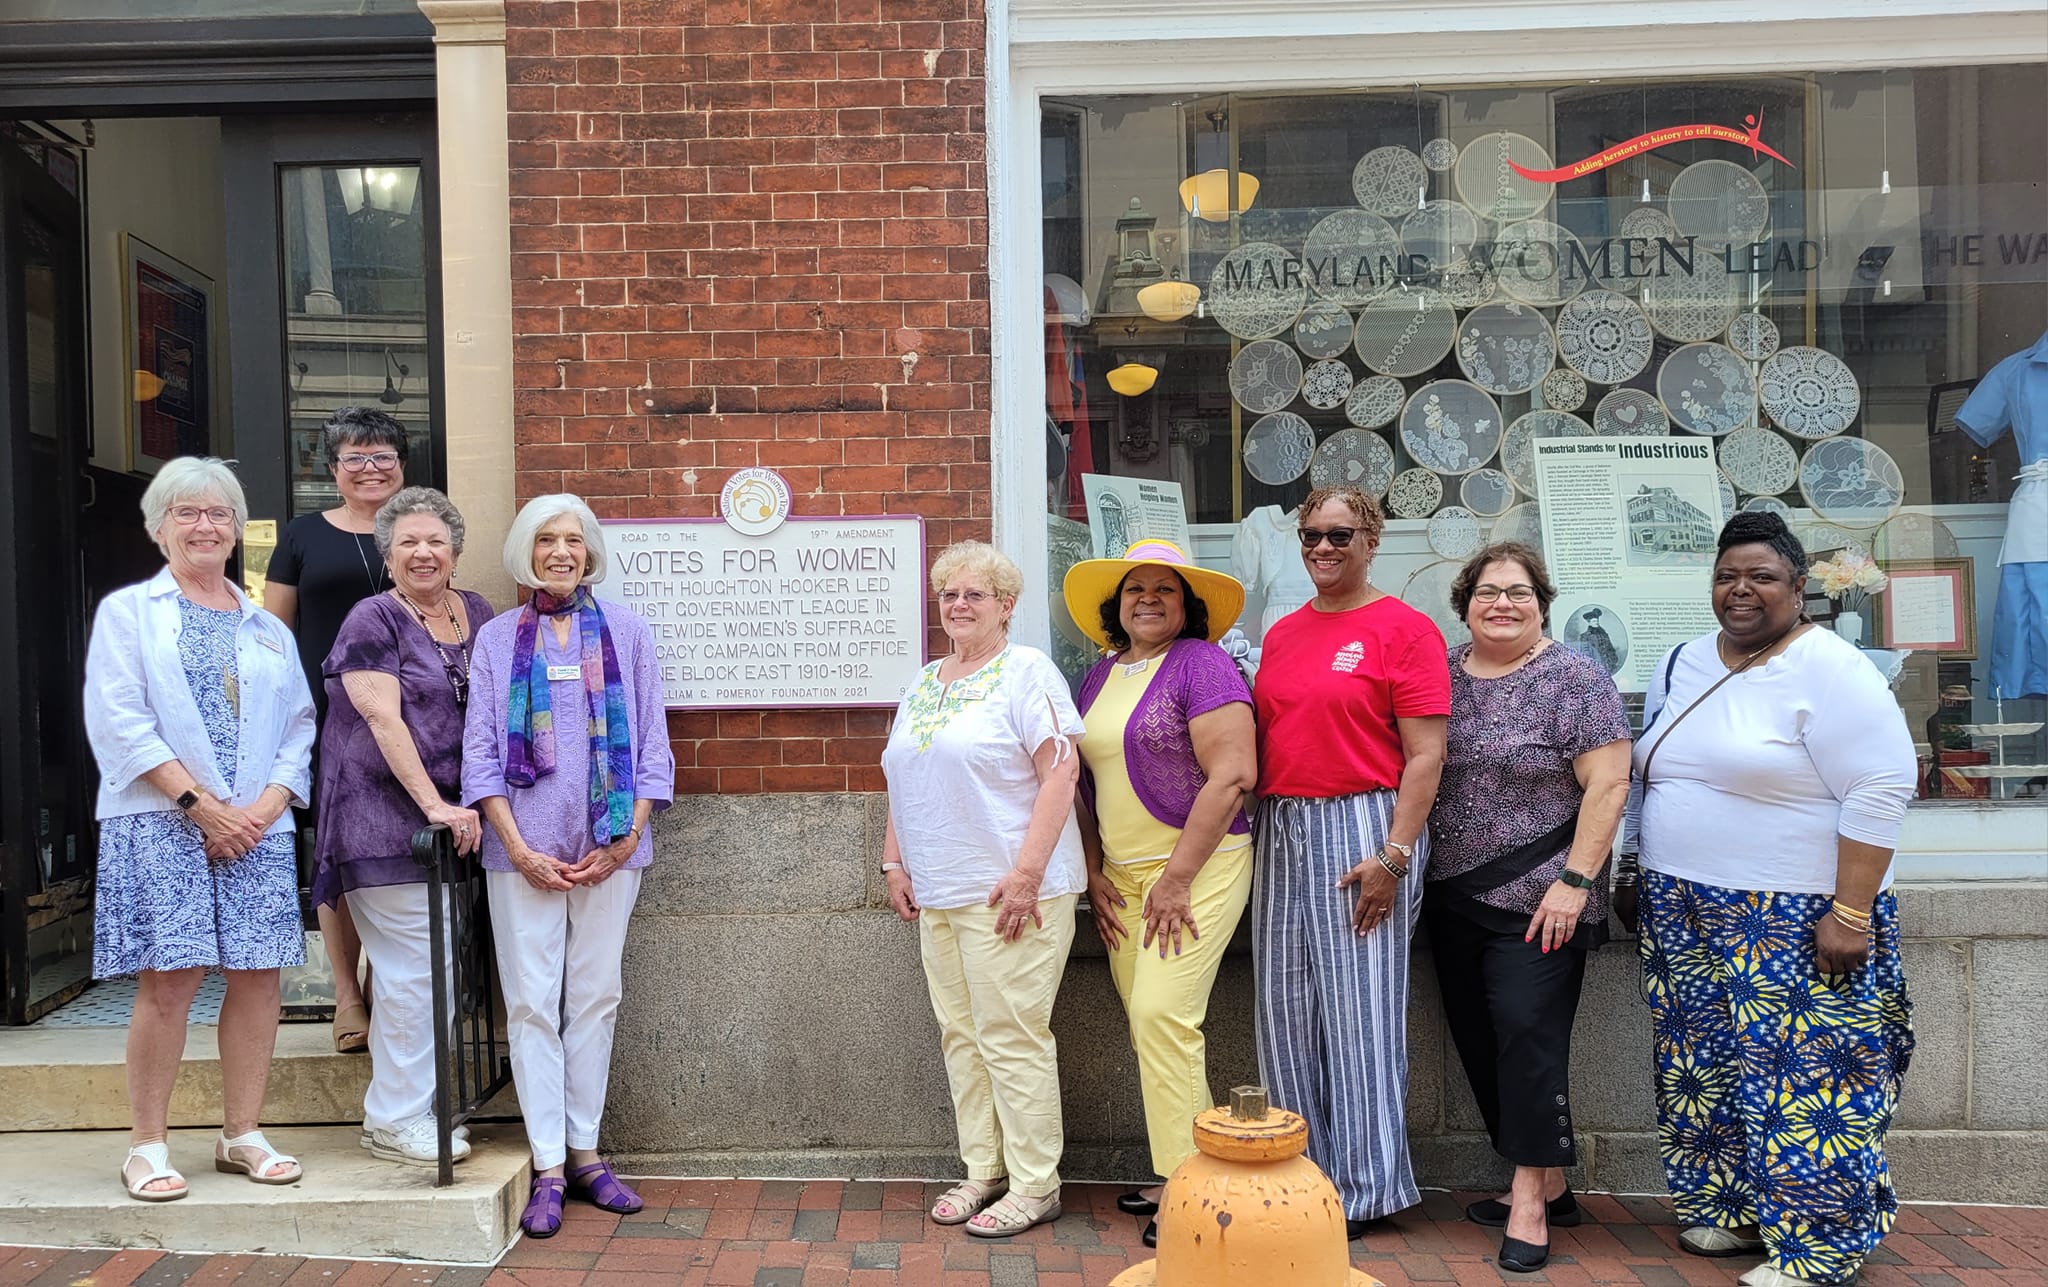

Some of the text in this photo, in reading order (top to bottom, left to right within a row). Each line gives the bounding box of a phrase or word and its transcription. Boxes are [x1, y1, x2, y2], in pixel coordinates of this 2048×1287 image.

[1573, 126, 1750, 176] Adding herstory to history to tell ourstory
[1225, 253, 1431, 291] MARYLAND
[1458, 234, 1699, 284] WOMEN
[1921, 233, 1985, 267] HE
[1539, 442, 1709, 459] Industrial Stands for Industrious
[722, 470, 788, 518] National Votes for Women Trail
[621, 531, 697, 543] ROAD TO THE
[836, 528, 894, 539] AMENDMENT
[616, 546, 895, 574] VOTES FOR WOMEN
[622, 576, 891, 597] EDITH HOUGHTON HOOKER LED
[675, 599, 794, 616] GOVERNMENT
[800, 598, 870, 615] LEAGUE
[876, 598, 892, 614] IN
[649, 618, 897, 639] TEWIDE WOMEN'S SUFFRAGE
[655, 640, 909, 660] CACY CAMPAIGN FROM OFFICE
[681, 664, 739, 682] BLOCK
[745, 663, 792, 680] EAST
[797, 662, 873, 680] 1910-1912.
[716, 687, 765, 698] POMEROY
[771, 686, 838, 698] FOUNDATION
[844, 686, 868, 697] 2021
